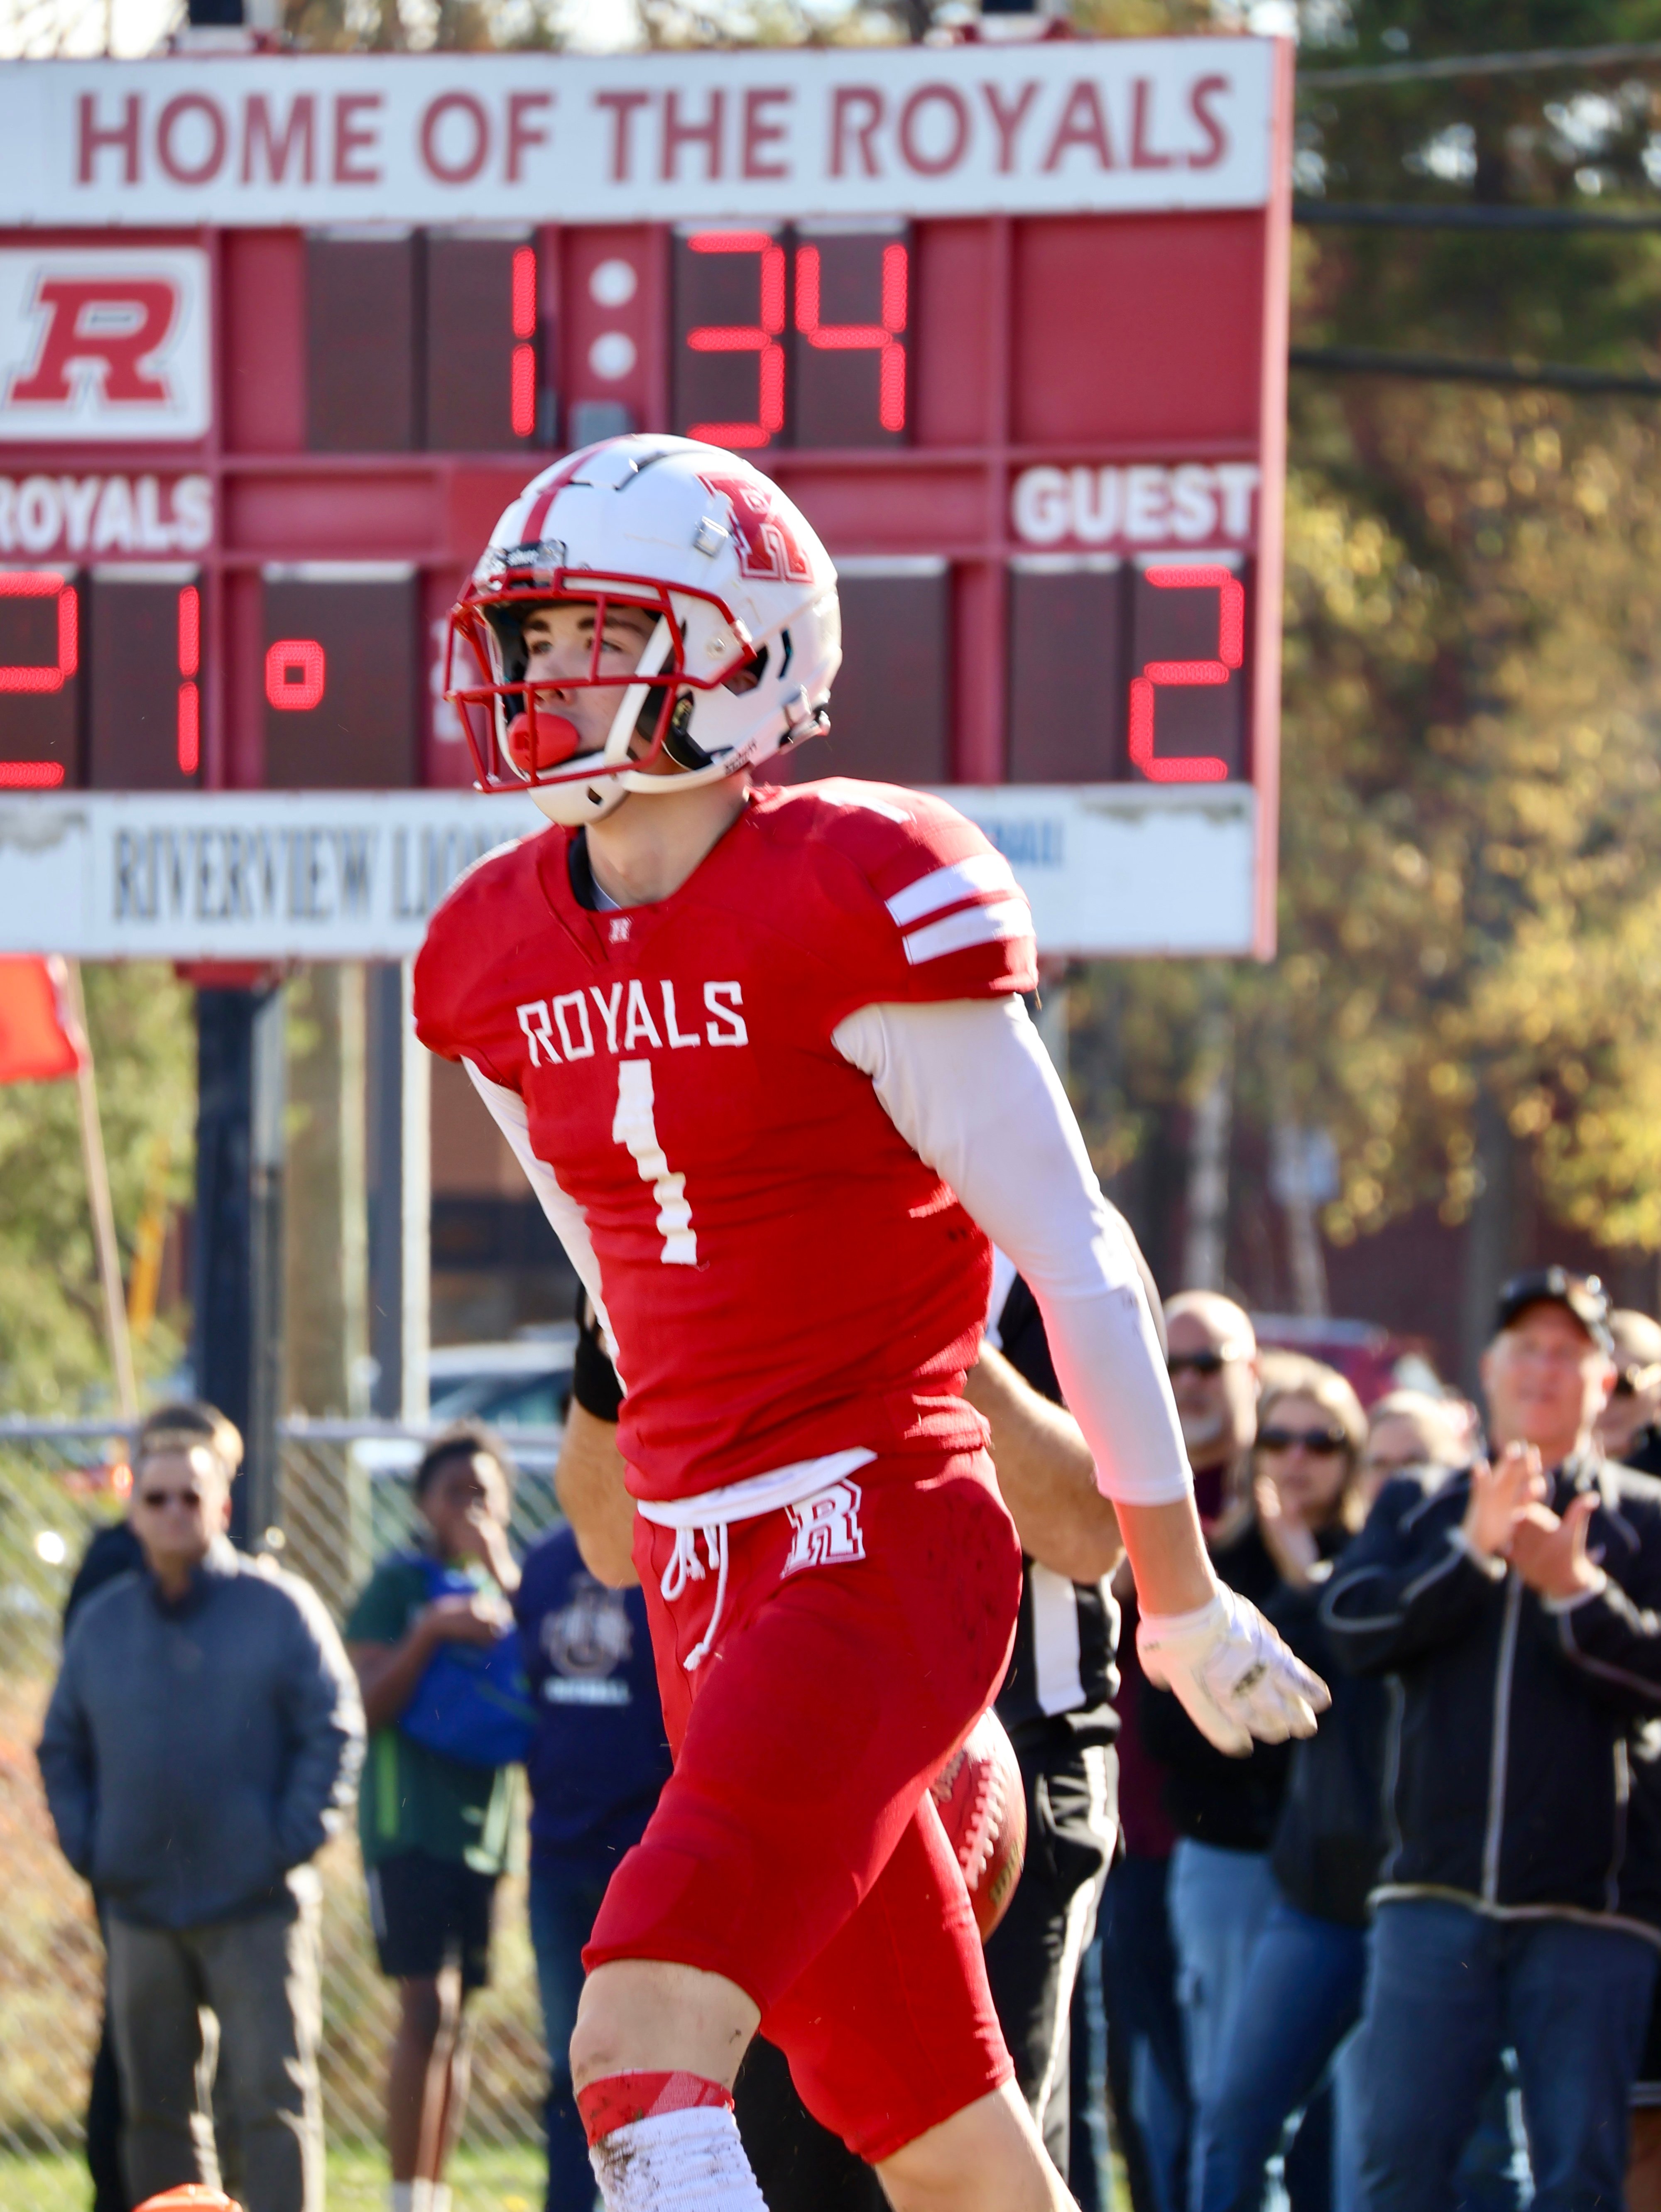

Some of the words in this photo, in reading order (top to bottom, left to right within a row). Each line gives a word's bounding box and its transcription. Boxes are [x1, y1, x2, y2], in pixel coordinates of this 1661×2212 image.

[76, 91, 384, 187] HOME
[417, 90, 554, 186] OF
[594, 88, 791, 183] THE
[830, 73, 1231, 179] ROYALS
[6, 274, 181, 409] R
[1013, 463, 1260, 542] GUEST
[1129, 565, 1244, 782] 2
[114, 824, 377, 921] RIVERVIEW
[516, 979, 749, 1067] ROYALS
[612, 1058, 698, 1265] 1
[779, 1477, 866, 1580] R
